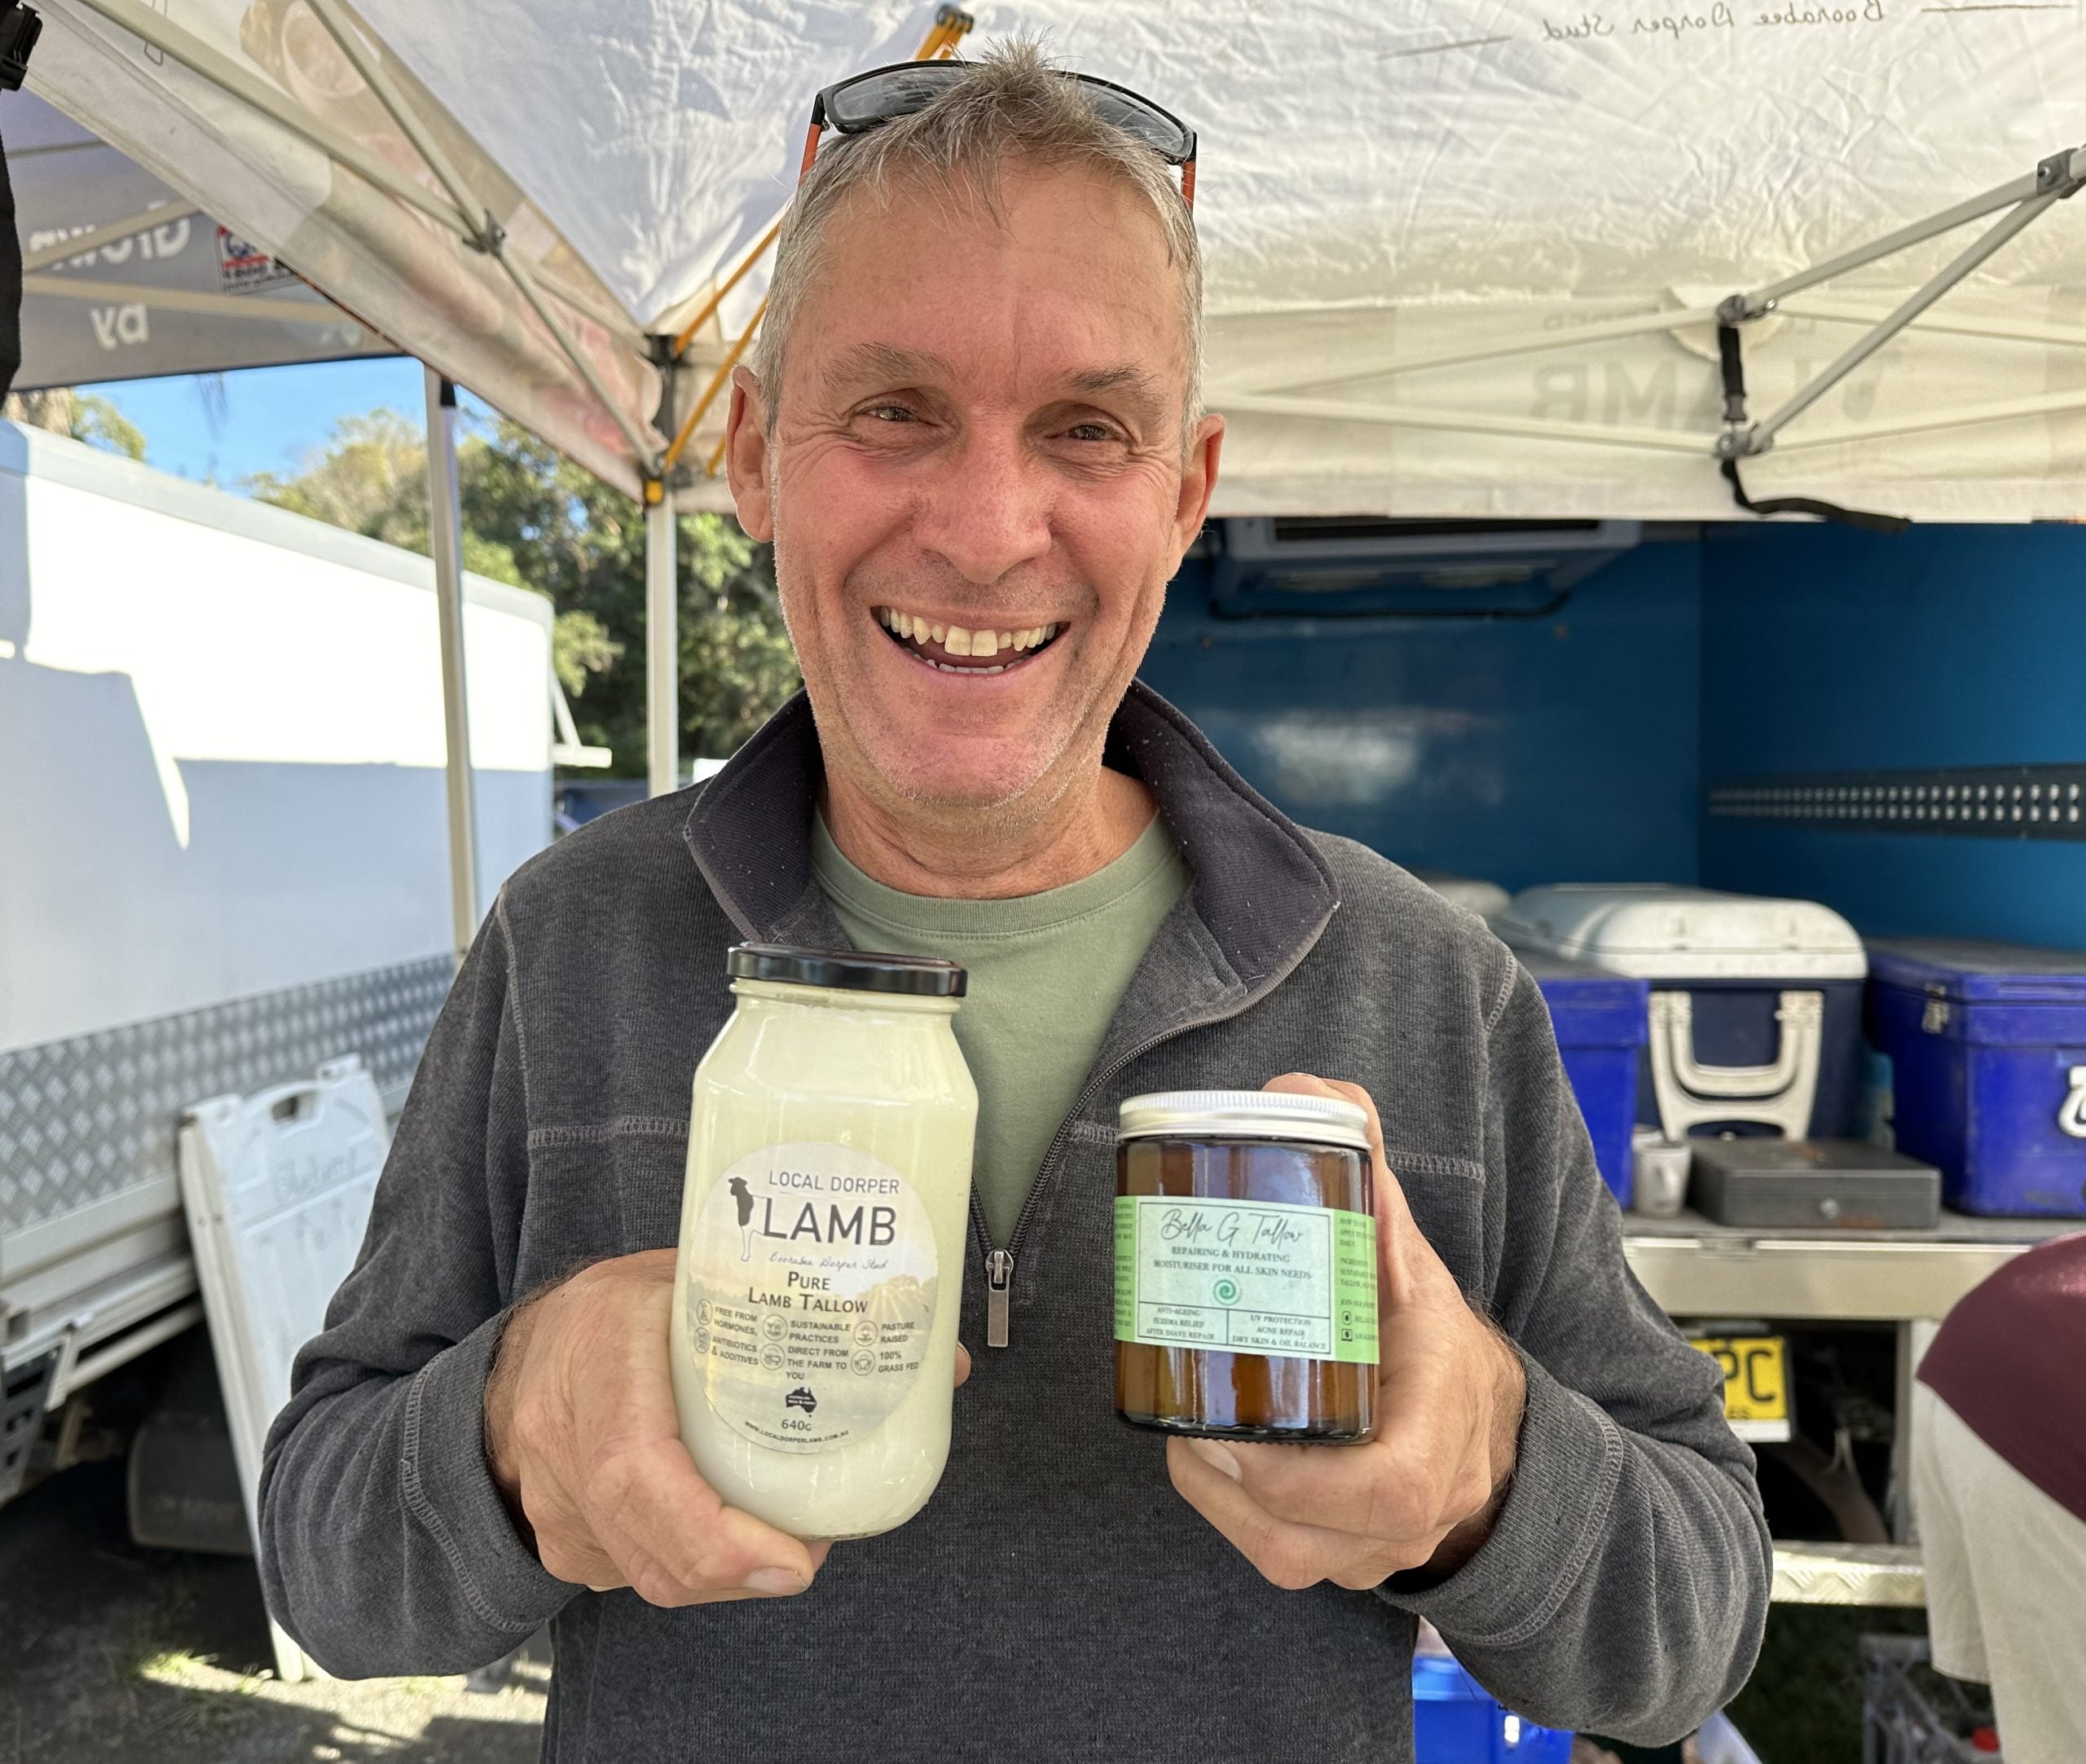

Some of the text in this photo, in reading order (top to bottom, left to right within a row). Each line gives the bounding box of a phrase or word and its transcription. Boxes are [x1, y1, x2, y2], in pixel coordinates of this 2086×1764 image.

[768, 1170, 900, 1194] LOCAL DORPER
[764, 1198, 896, 1246] LAMB
[1160, 1208, 1212, 1243] Bella
[1217, 1212, 1240, 1247] G
[1248, 1212, 1304, 1250] Tallow
[1172, 1246, 1290, 1262] REPAIRING & HYDRATING
[1154, 1260, 1311, 1279] MOISTURISER FOR ALL SKIN NEEDS
[715, 1306, 757, 1322] FREE FROM
[1156, 1307, 1200, 1317] ANTI-AGEING
[1180, 1320, 1205, 1328] RELIEF
[1251, 1314, 1311, 1326] UV PROTECTION
[714, 1319, 758, 1336] HORMONES,
[790, 1321, 851, 1332] SUSTAINABLE
[882, 1322, 915, 1331] PASTURE
[1256, 1326, 1305, 1337] ACNE REPAIR
[789, 1333, 839, 1344] PRACTICES
[881, 1335, 908, 1344] RAISED
[1146, 1328, 1215, 1341] AFTER SHAVE REPAIR
[712, 1335, 757, 1353] ANTIBIOTICS
[1232, 1335, 1249, 1344] DRY
[1251, 1337, 1269, 1345] SKIN
[1294, 1340, 1327, 1349] BALANCE
[711, 1346, 759, 1366] & ADDITIVES
[788, 1346, 849, 1357] DIRECT FROM
[880, 1351, 901, 1360] 100%
[787, 1359, 847, 1370] THE FARM TO
[878, 1361, 919, 1373] GRASS FED
[786, 1371, 805, 1380] YOU
